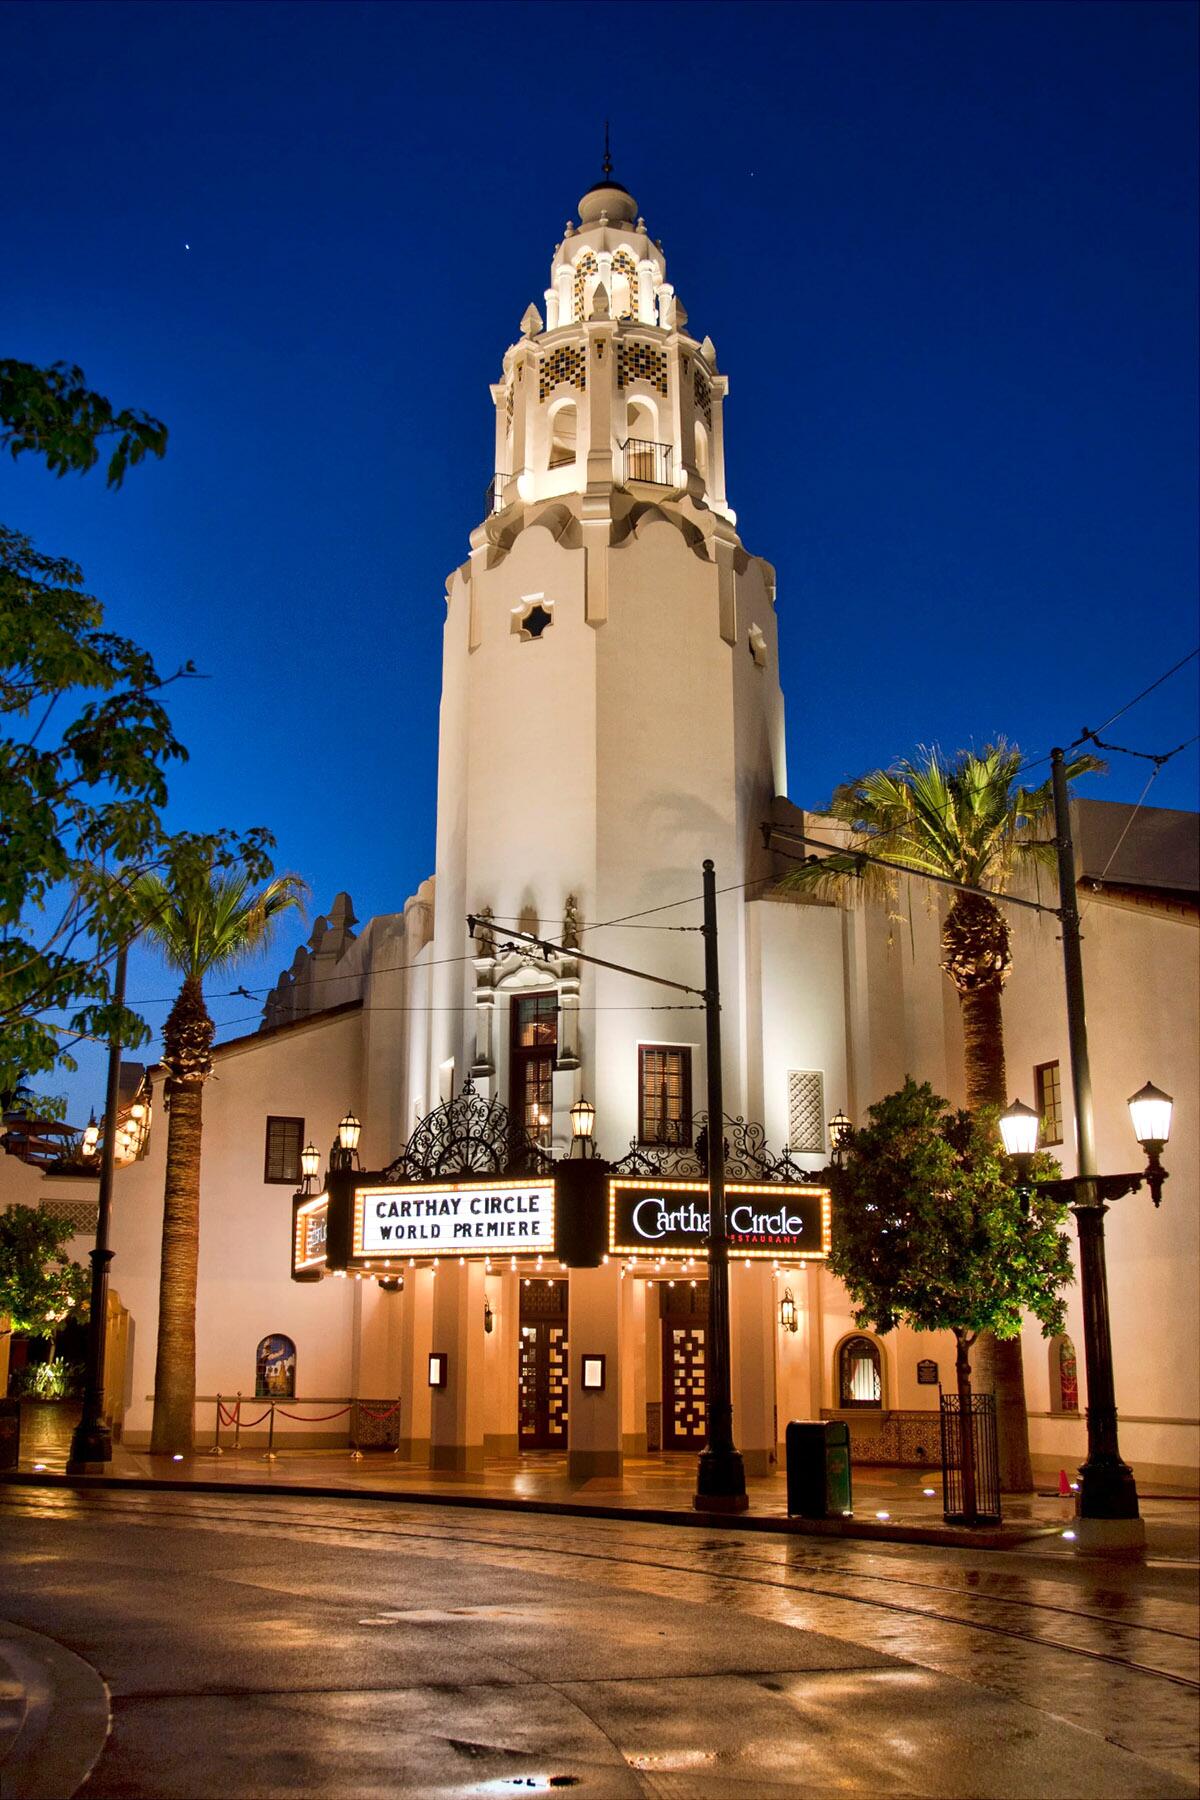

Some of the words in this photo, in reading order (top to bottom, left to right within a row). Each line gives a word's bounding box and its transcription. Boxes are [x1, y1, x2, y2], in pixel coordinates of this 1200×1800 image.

[376, 1197, 461, 1218] CARTHAY
[470, 1195, 540, 1215] CIRCLE
[633, 1198, 727, 1238] Cartha
[731, 1206, 803, 1233] Circle
[380, 1224, 441, 1240] WORLD
[454, 1221, 540, 1238] PREMIERE
[725, 1233, 798, 1244] ESTAURANT
